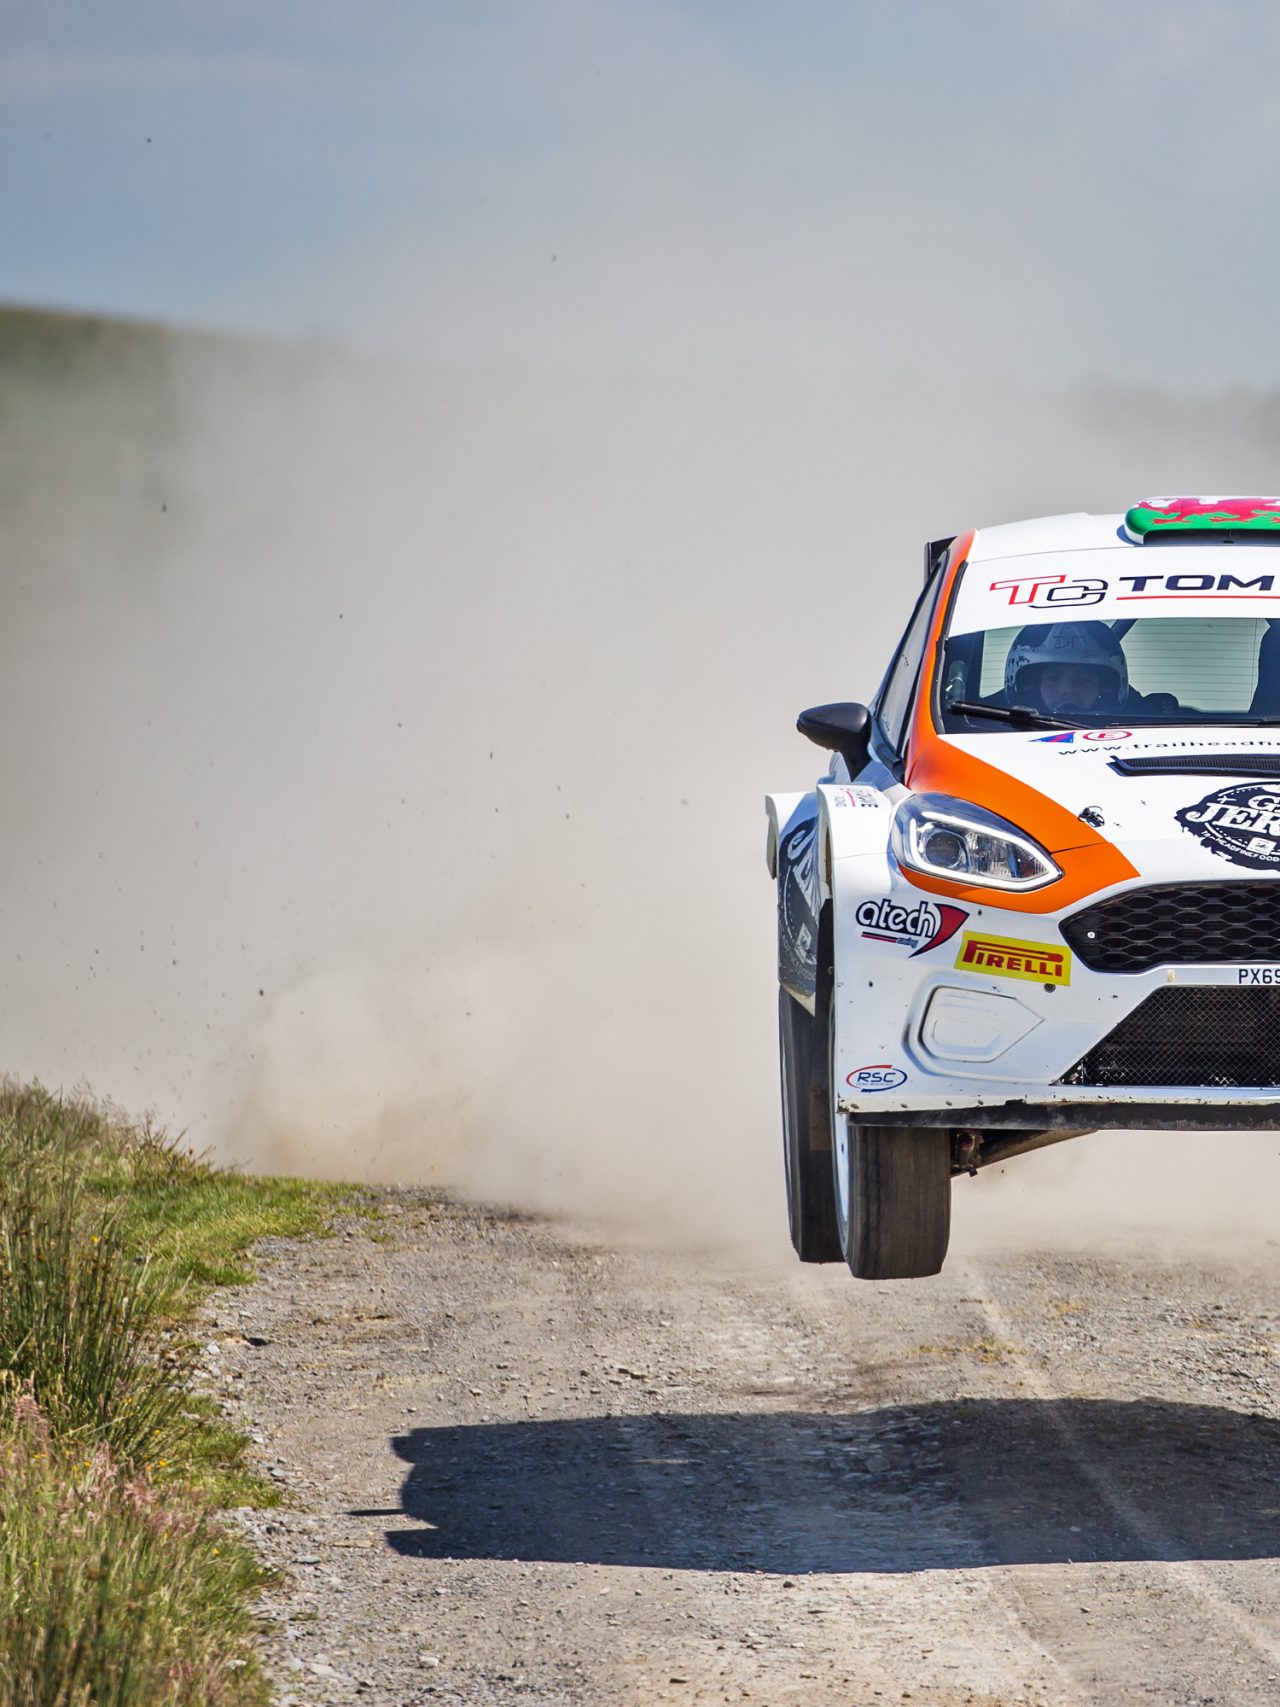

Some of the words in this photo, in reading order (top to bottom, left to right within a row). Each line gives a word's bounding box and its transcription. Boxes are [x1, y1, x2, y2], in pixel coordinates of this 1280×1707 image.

[1119, 575, 1275, 592] TOM
[856, 898, 938, 938] atech
[962, 939, 1064, 977] PIRELLI
[857, 1071, 896, 1083] RSC
